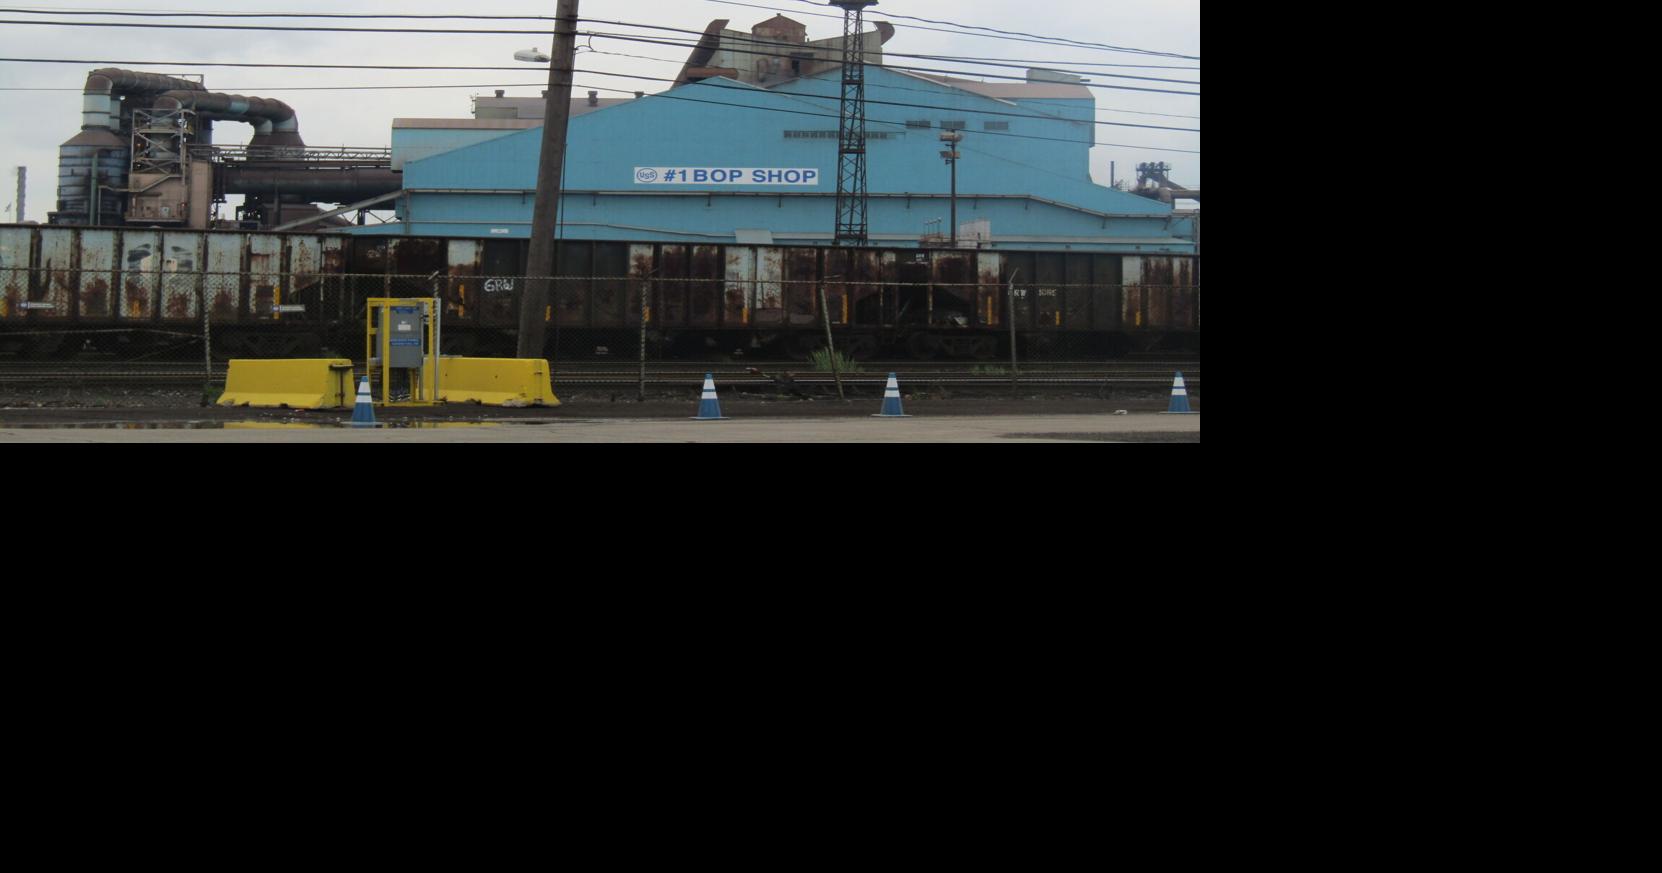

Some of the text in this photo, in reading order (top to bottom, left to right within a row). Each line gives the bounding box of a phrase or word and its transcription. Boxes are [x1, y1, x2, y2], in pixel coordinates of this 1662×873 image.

[639, 169, 816, 183] USS #1 BOP SHOP
